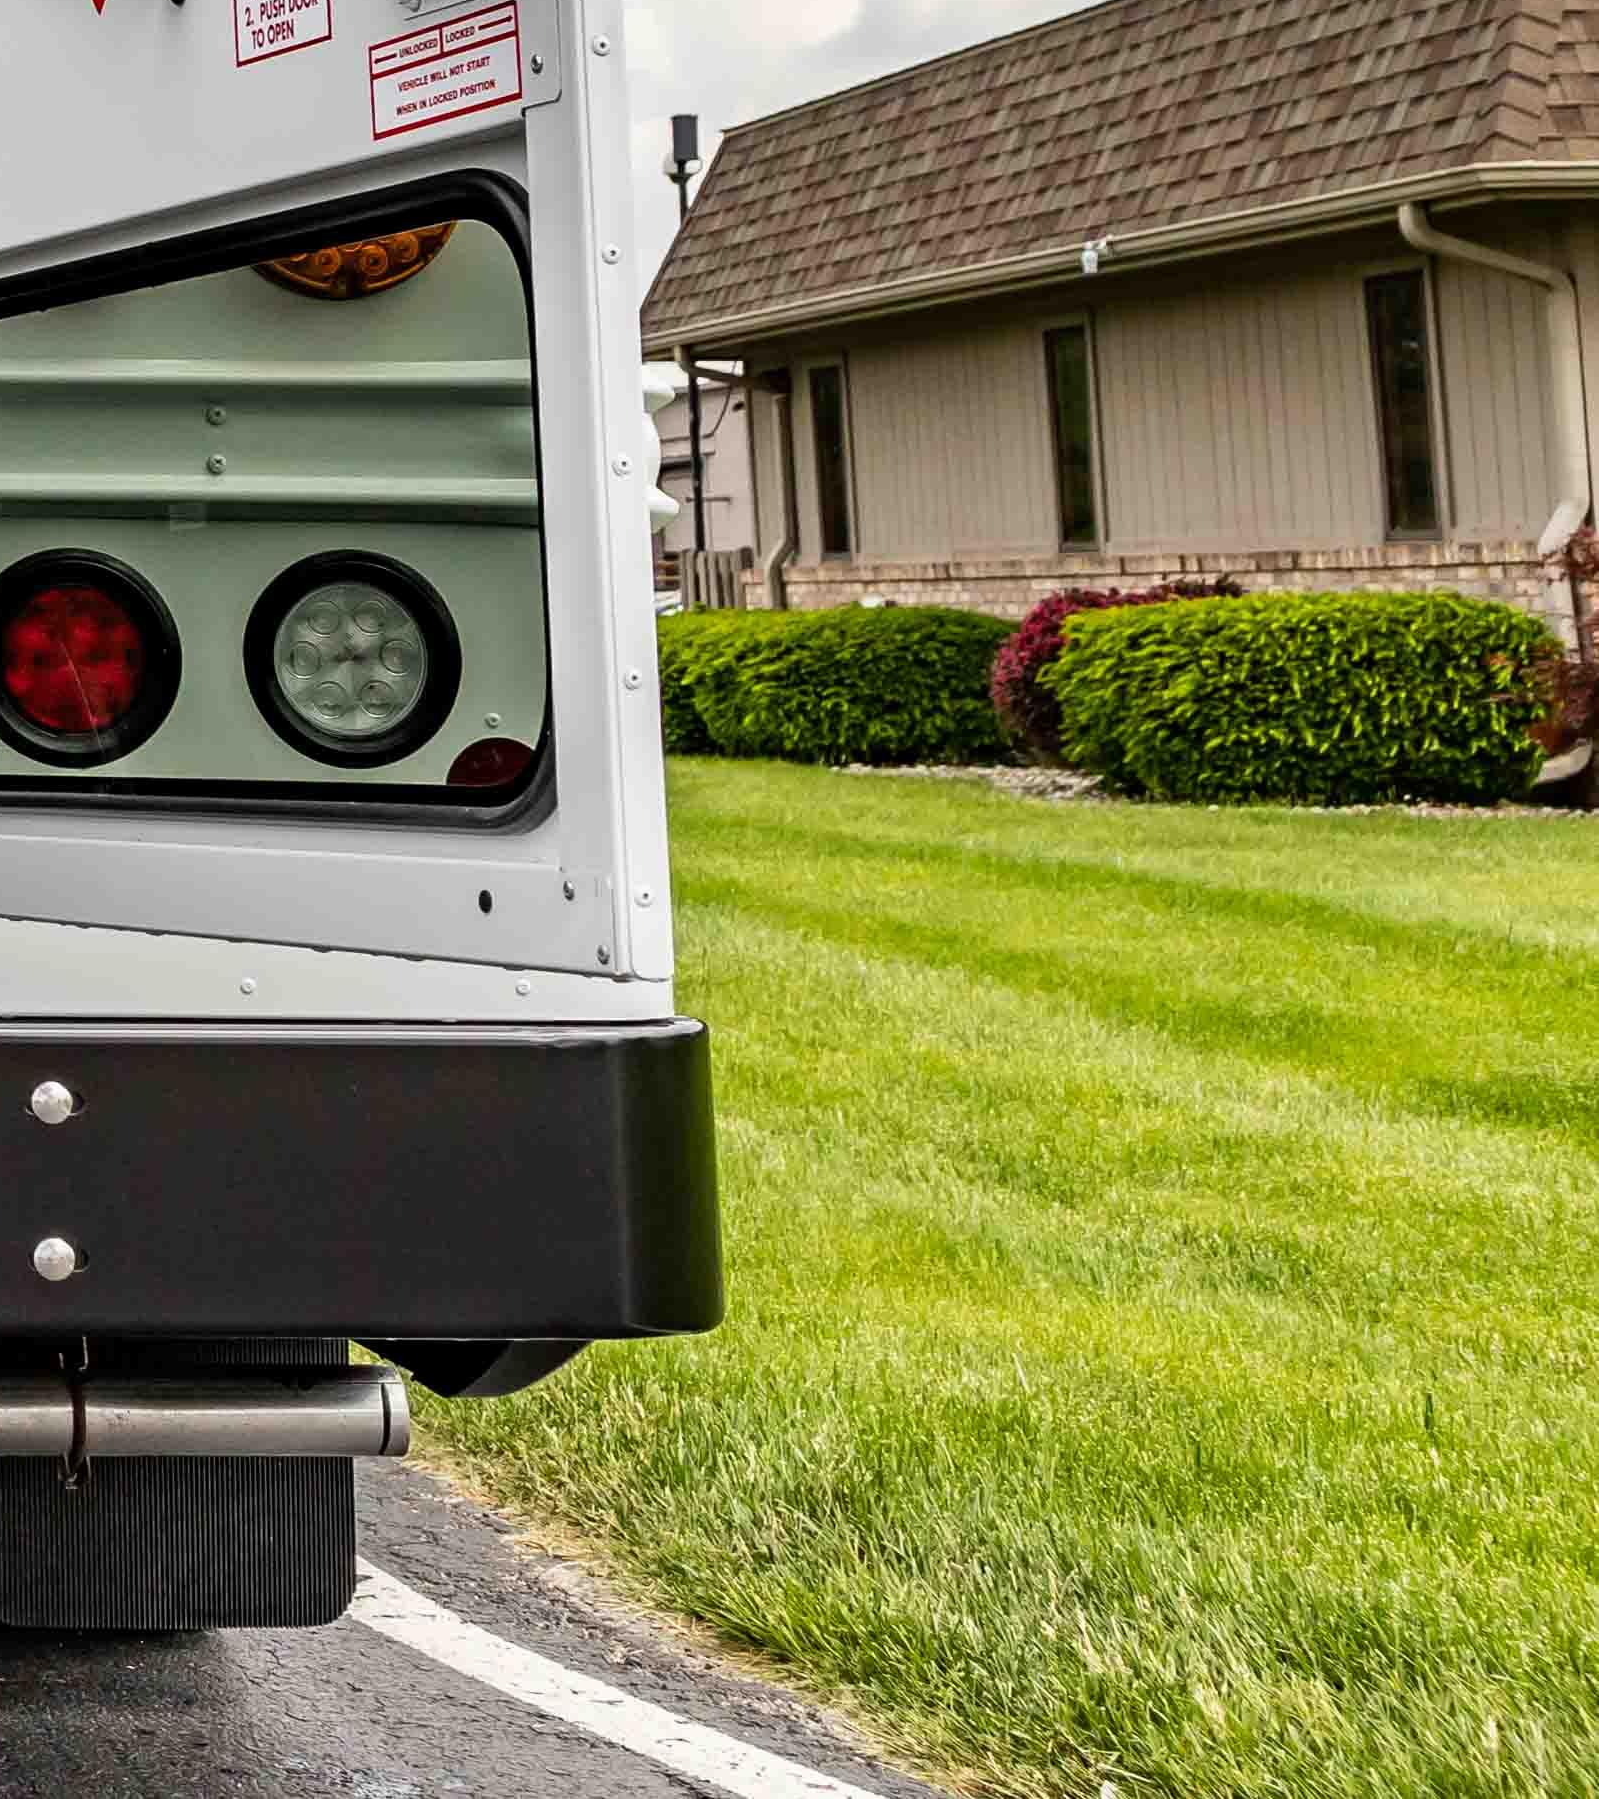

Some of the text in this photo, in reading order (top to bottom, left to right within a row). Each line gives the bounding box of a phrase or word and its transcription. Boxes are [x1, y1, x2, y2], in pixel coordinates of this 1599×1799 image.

[245, 7, 254, 27] 2.
[252, 19, 294, 50] TO OPEN
[445, 26, 475, 43] LOCKED
[399, 38, 438, 58] UNLOCKED
[398, 55, 491, 93] VEHICLE WILL NOT START
[396, 79, 496, 116] WHEN IN LOCKED POSITION
